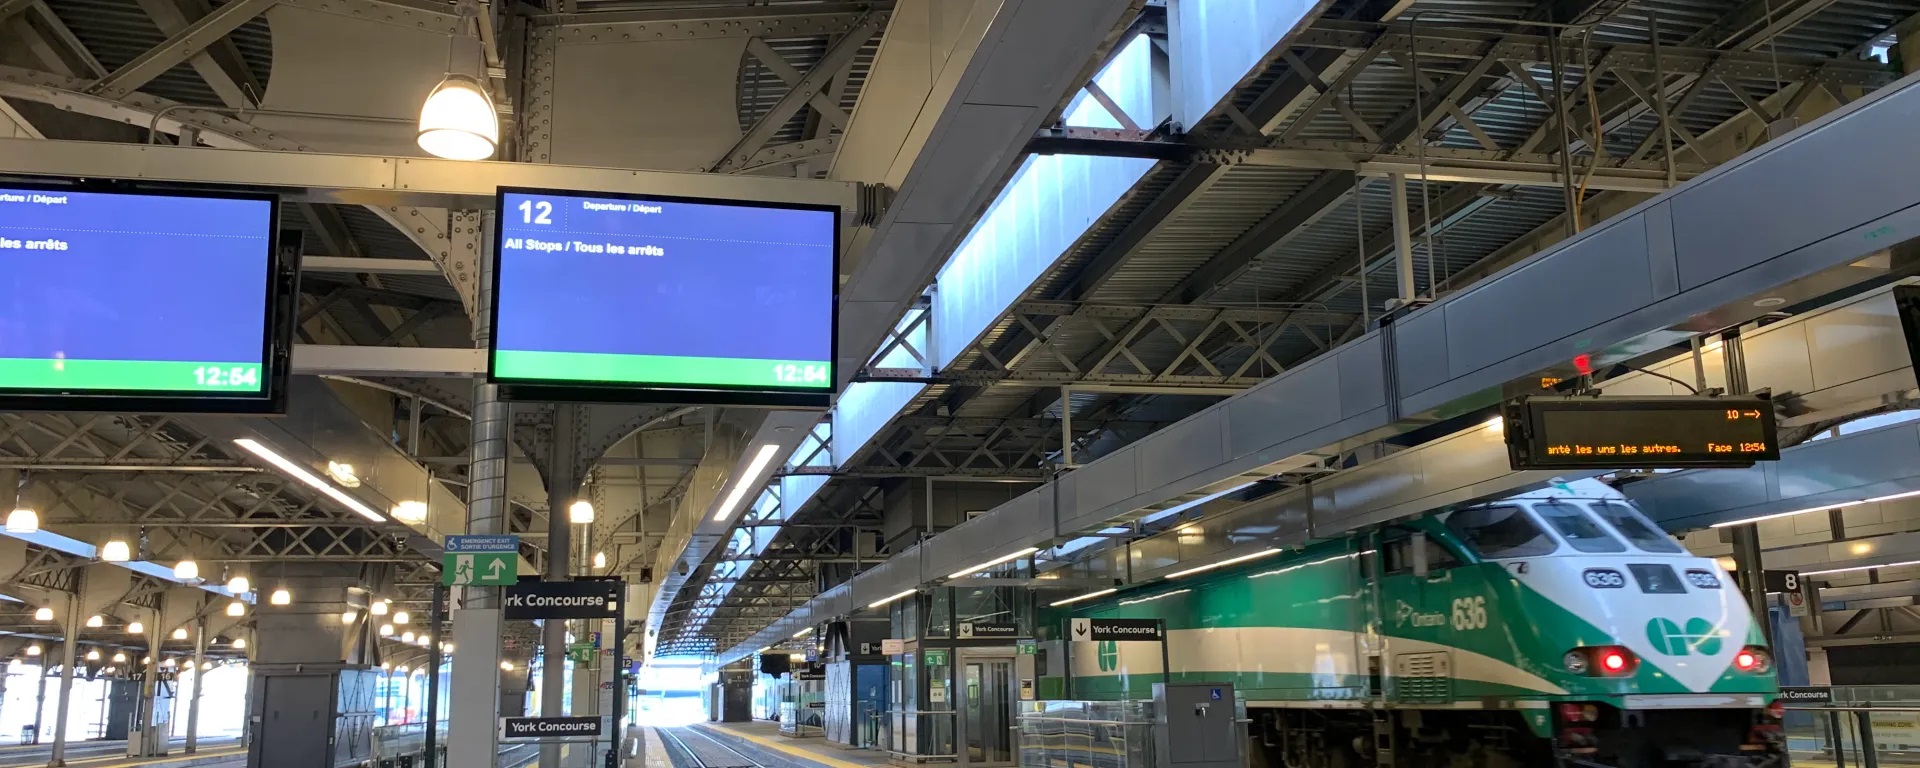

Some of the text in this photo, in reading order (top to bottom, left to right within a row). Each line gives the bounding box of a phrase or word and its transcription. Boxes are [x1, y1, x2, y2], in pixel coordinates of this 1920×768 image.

[26, 194, 32, 203] /
[33, 194, 68, 205] Départ
[518, 200, 553, 225] 12
[583, 201, 662, 214] Departure / Départ
[0, 237, 69, 251] les arrêts
[505, 238, 664, 256] All Stops / Tous les arrêts
[193, 366, 257, 386] 12:54
[773, 364, 827, 383] 12:54
[1727, 410, 1739, 419] 10
[1576, 444, 1592, 454] les
[1597, 445, 1616, 454] uns
[1621, 444, 1638, 454] les
[1642, 444, 1681, 454] autres.
[1708, 443, 1765, 453] Face 12:54
[1586, 573, 1622, 585] 636
[1785, 573, 1798, 590] 8
[504, 594, 604, 607] rk Concourse
[1452, 596, 1487, 630] 636
[1093, 626, 1155, 634] York Concourse
[589, 633, 597, 642] 8
[1789, 691, 1828, 699] Concourse
[512, 722, 596, 732] York Concourse
